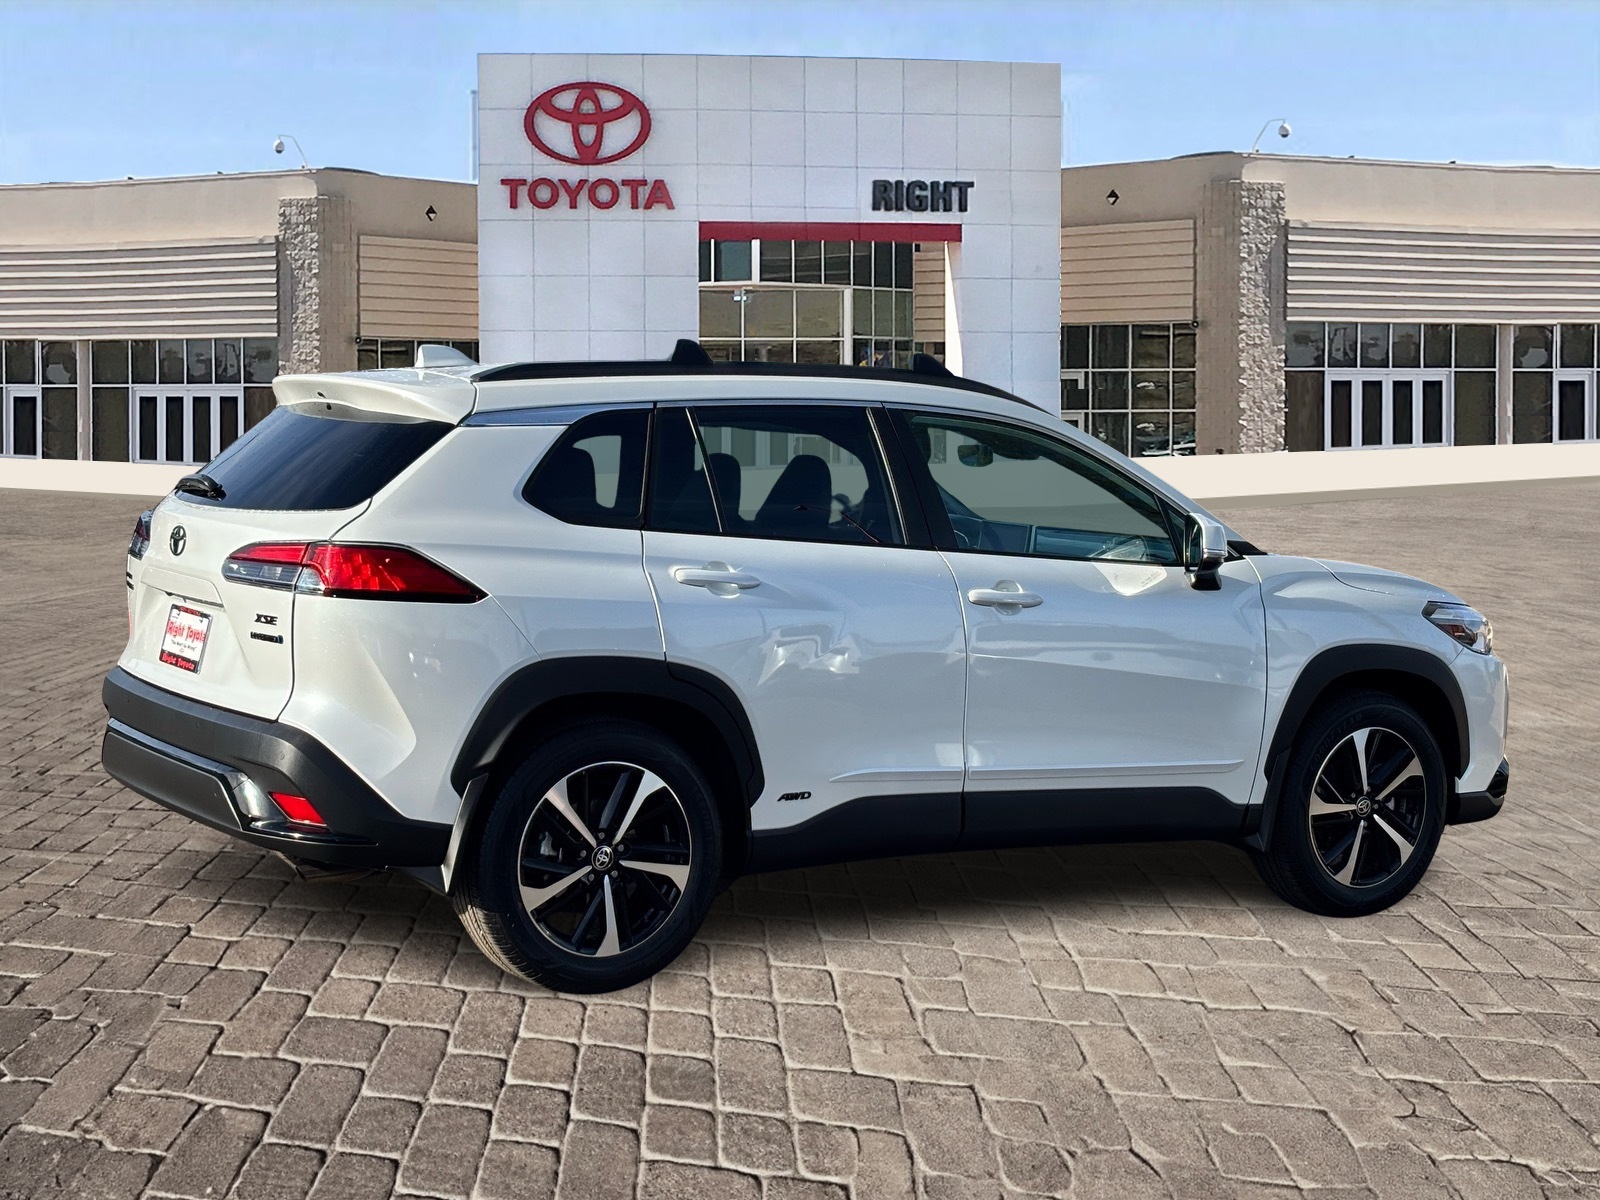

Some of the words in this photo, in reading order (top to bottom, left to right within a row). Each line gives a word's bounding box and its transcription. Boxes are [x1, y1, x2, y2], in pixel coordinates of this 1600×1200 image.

[500, 178, 675, 210] TOYOTA
[871, 179, 975, 213] RIGHT
[254, 613, 278, 626] XSE
[167, 620, 185, 638] Right
[185, 625, 206, 643] Toyota
[776, 791, 812, 802] AWD
